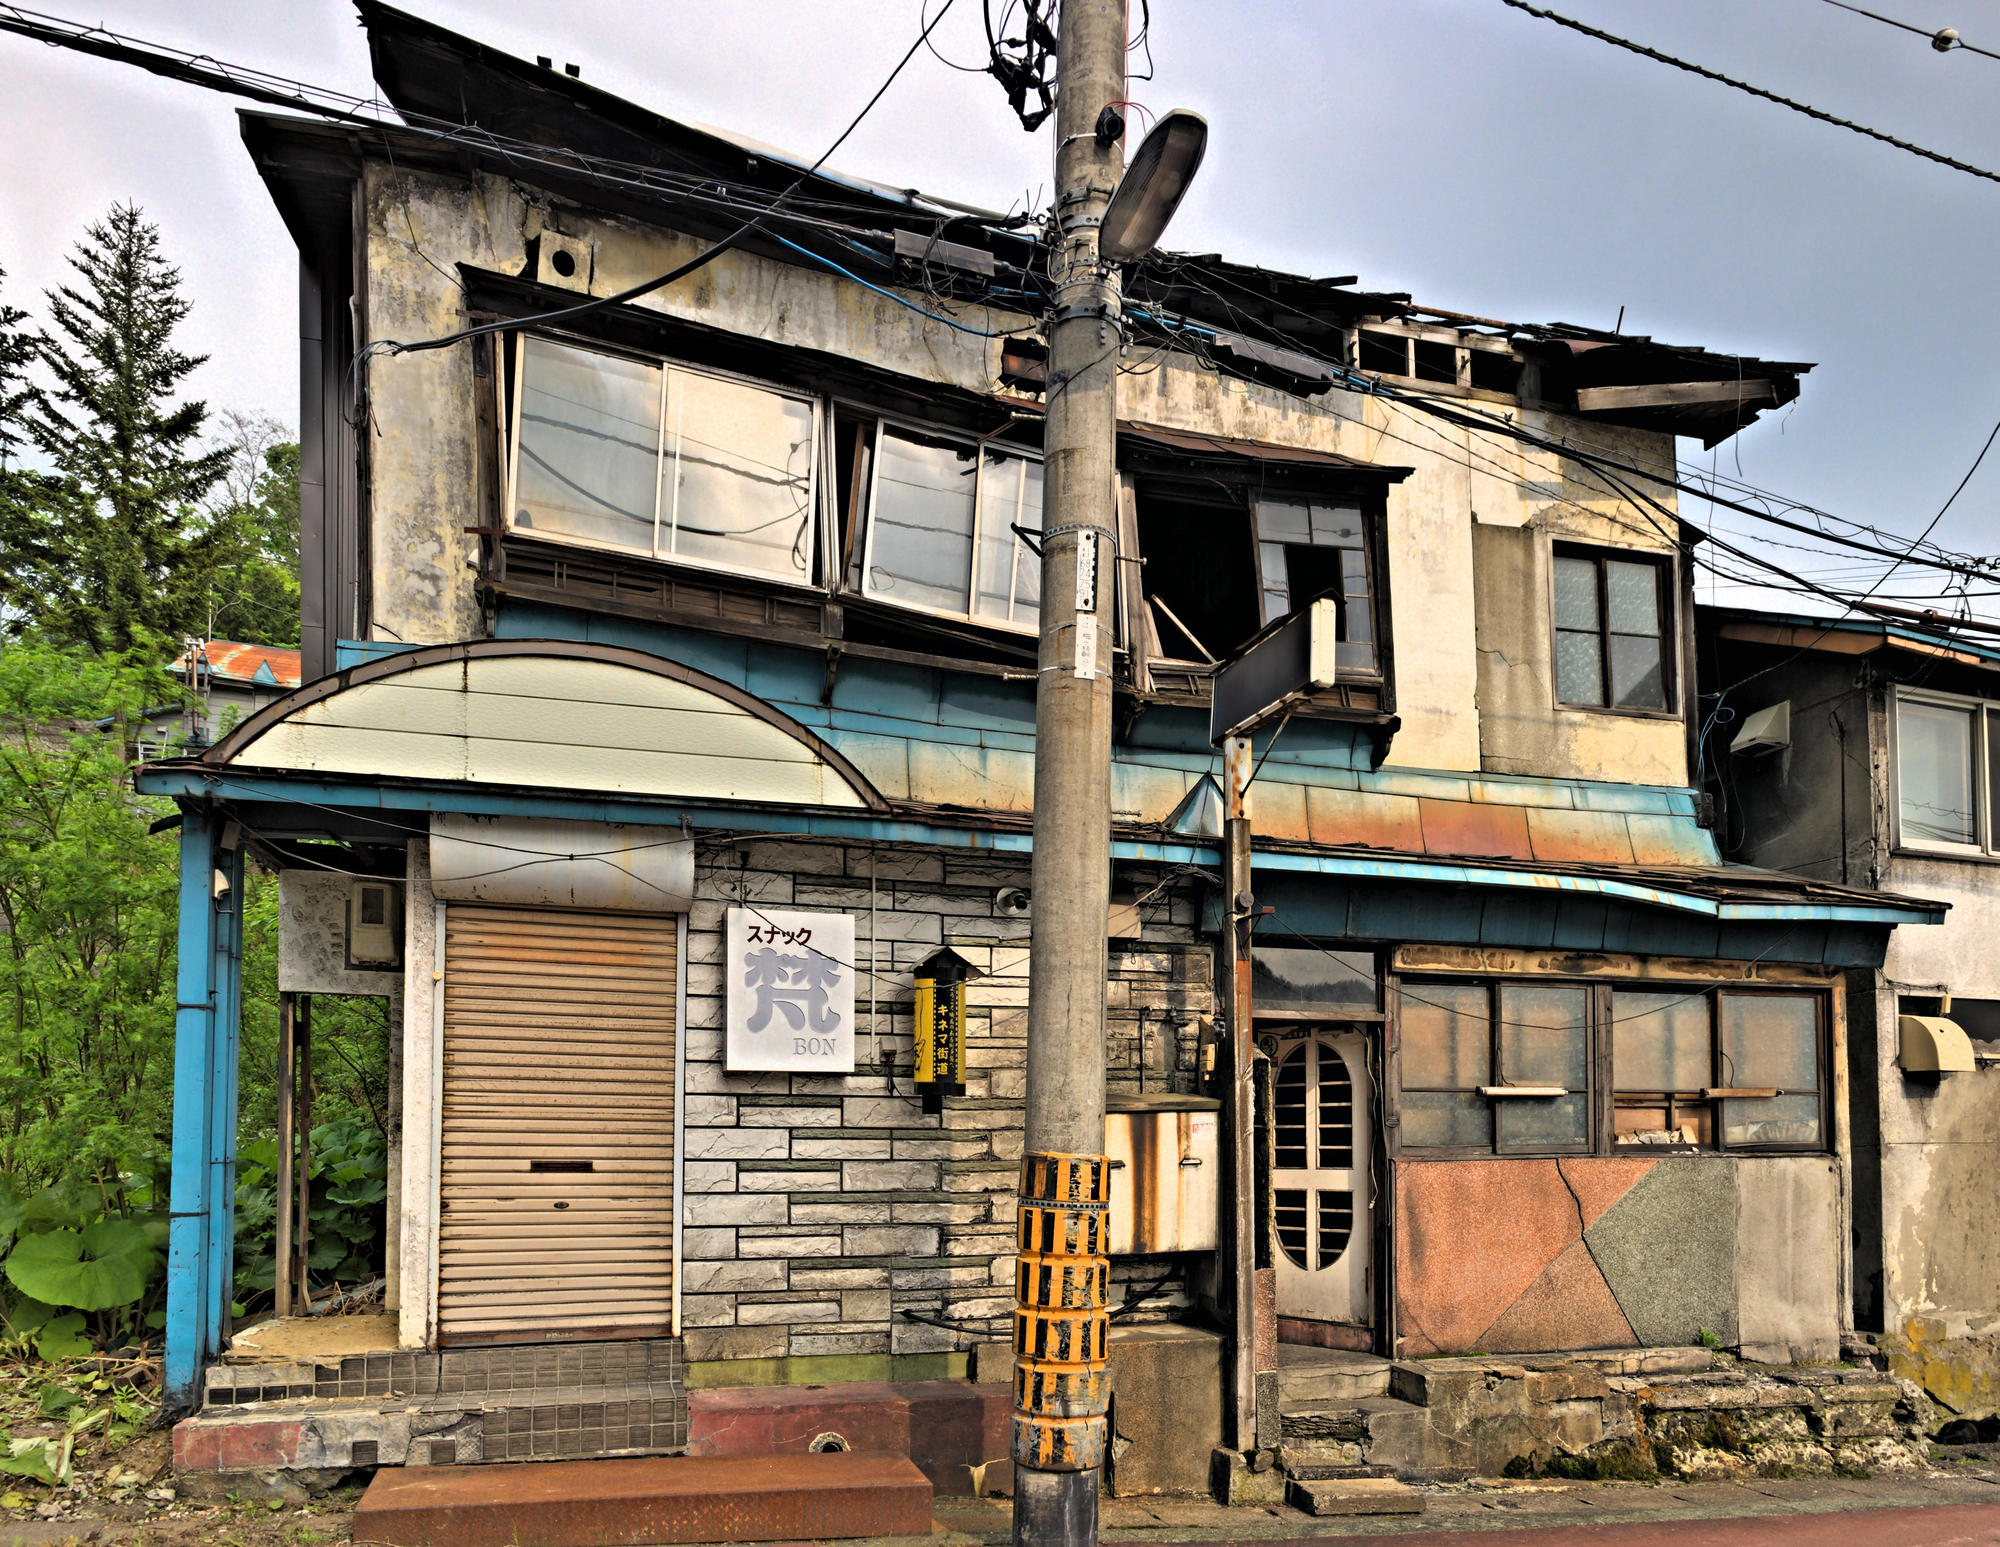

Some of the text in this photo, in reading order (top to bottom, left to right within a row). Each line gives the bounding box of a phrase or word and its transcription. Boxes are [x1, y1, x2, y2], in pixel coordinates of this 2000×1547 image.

[747, 925, 812, 946] スナック
[744, 947, 842, 1034] 梵
[793, 1037, 837, 1056] BON
[937, 1004, 949, 1075] キネマ街道
